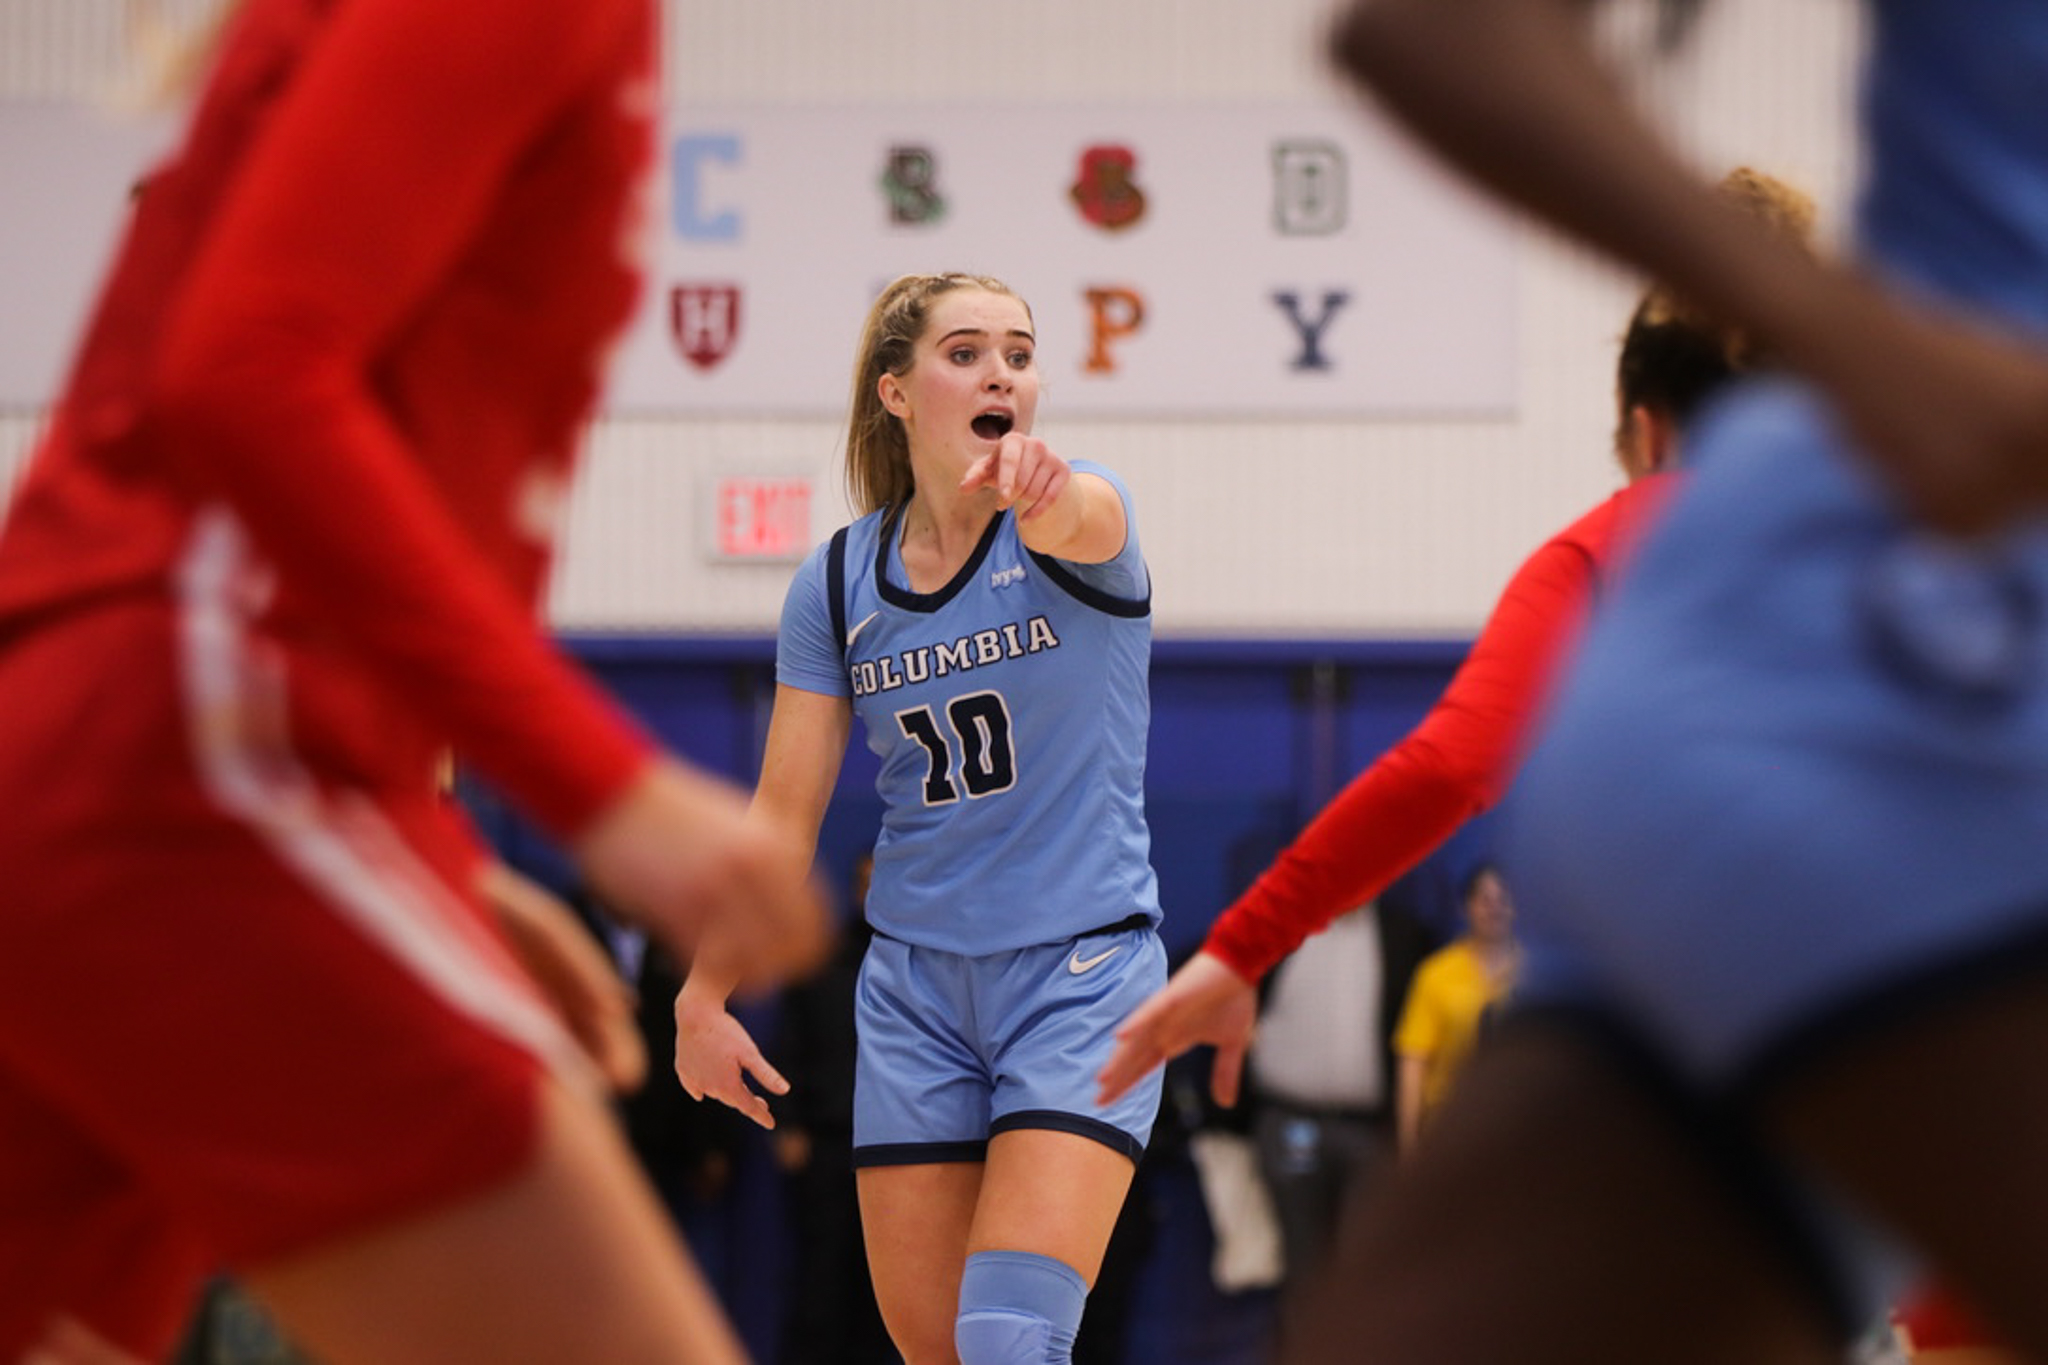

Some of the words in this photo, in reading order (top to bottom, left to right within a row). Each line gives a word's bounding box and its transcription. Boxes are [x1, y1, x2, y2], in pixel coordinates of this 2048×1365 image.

[673, 135, 743, 241] C
[1273, 140, 1349, 236] D
[1083, 287, 1145, 373] P
[1273, 289, 1351, 371] Y
[719, 480, 811, 556] EXIT
[850, 615, 1060, 698] COLUMBIA
[894, 689, 1017, 807] 10
